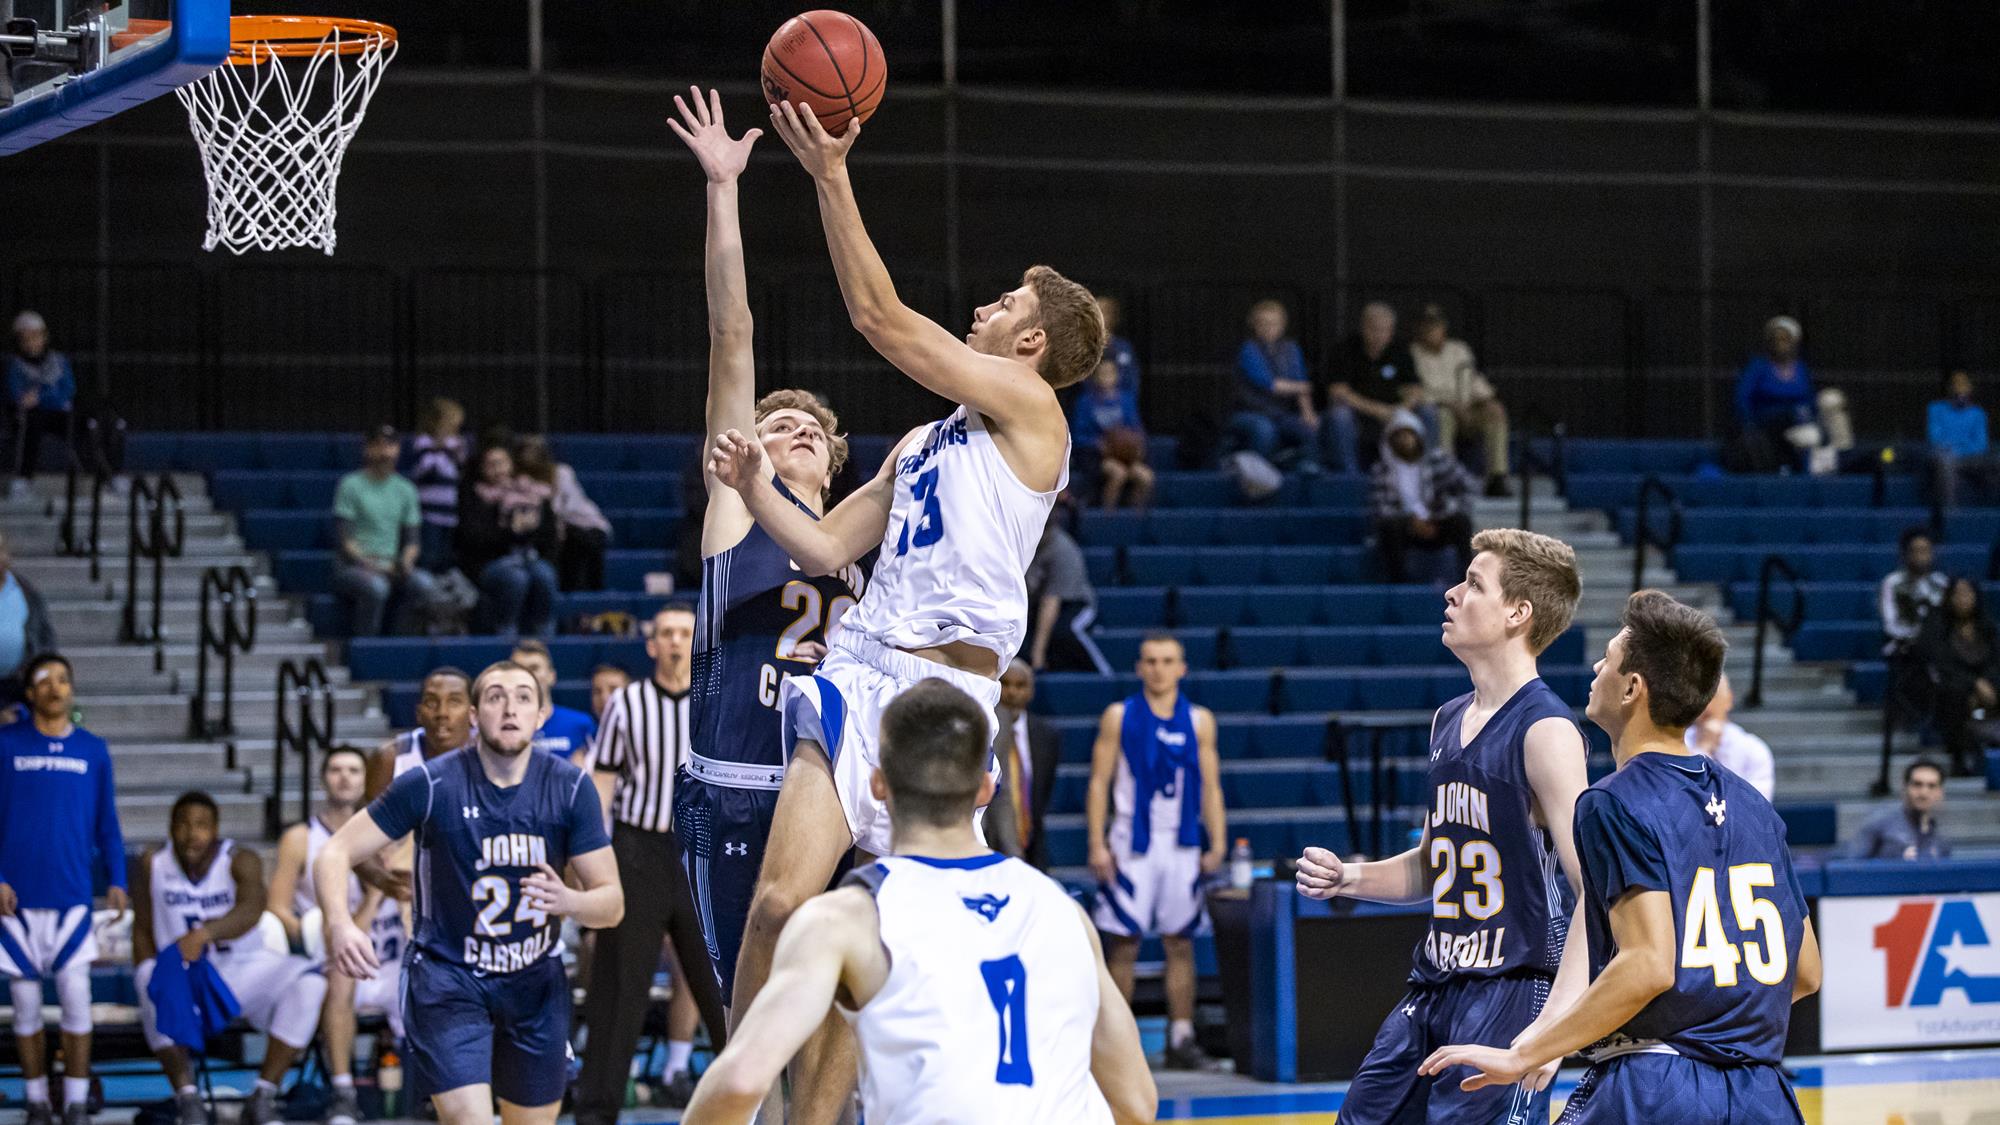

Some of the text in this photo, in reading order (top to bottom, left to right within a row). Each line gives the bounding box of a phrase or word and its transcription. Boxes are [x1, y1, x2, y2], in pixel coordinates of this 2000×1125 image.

[896, 465, 944, 557] 13
[1431, 781, 1491, 835] JOHN
[474, 833, 547, 871] JOHN
[1430, 836, 1505, 921] 23
[471, 875, 550, 935] 24
[1678, 862, 1788, 988] 45
[463, 924, 553, 973] CARROLL
